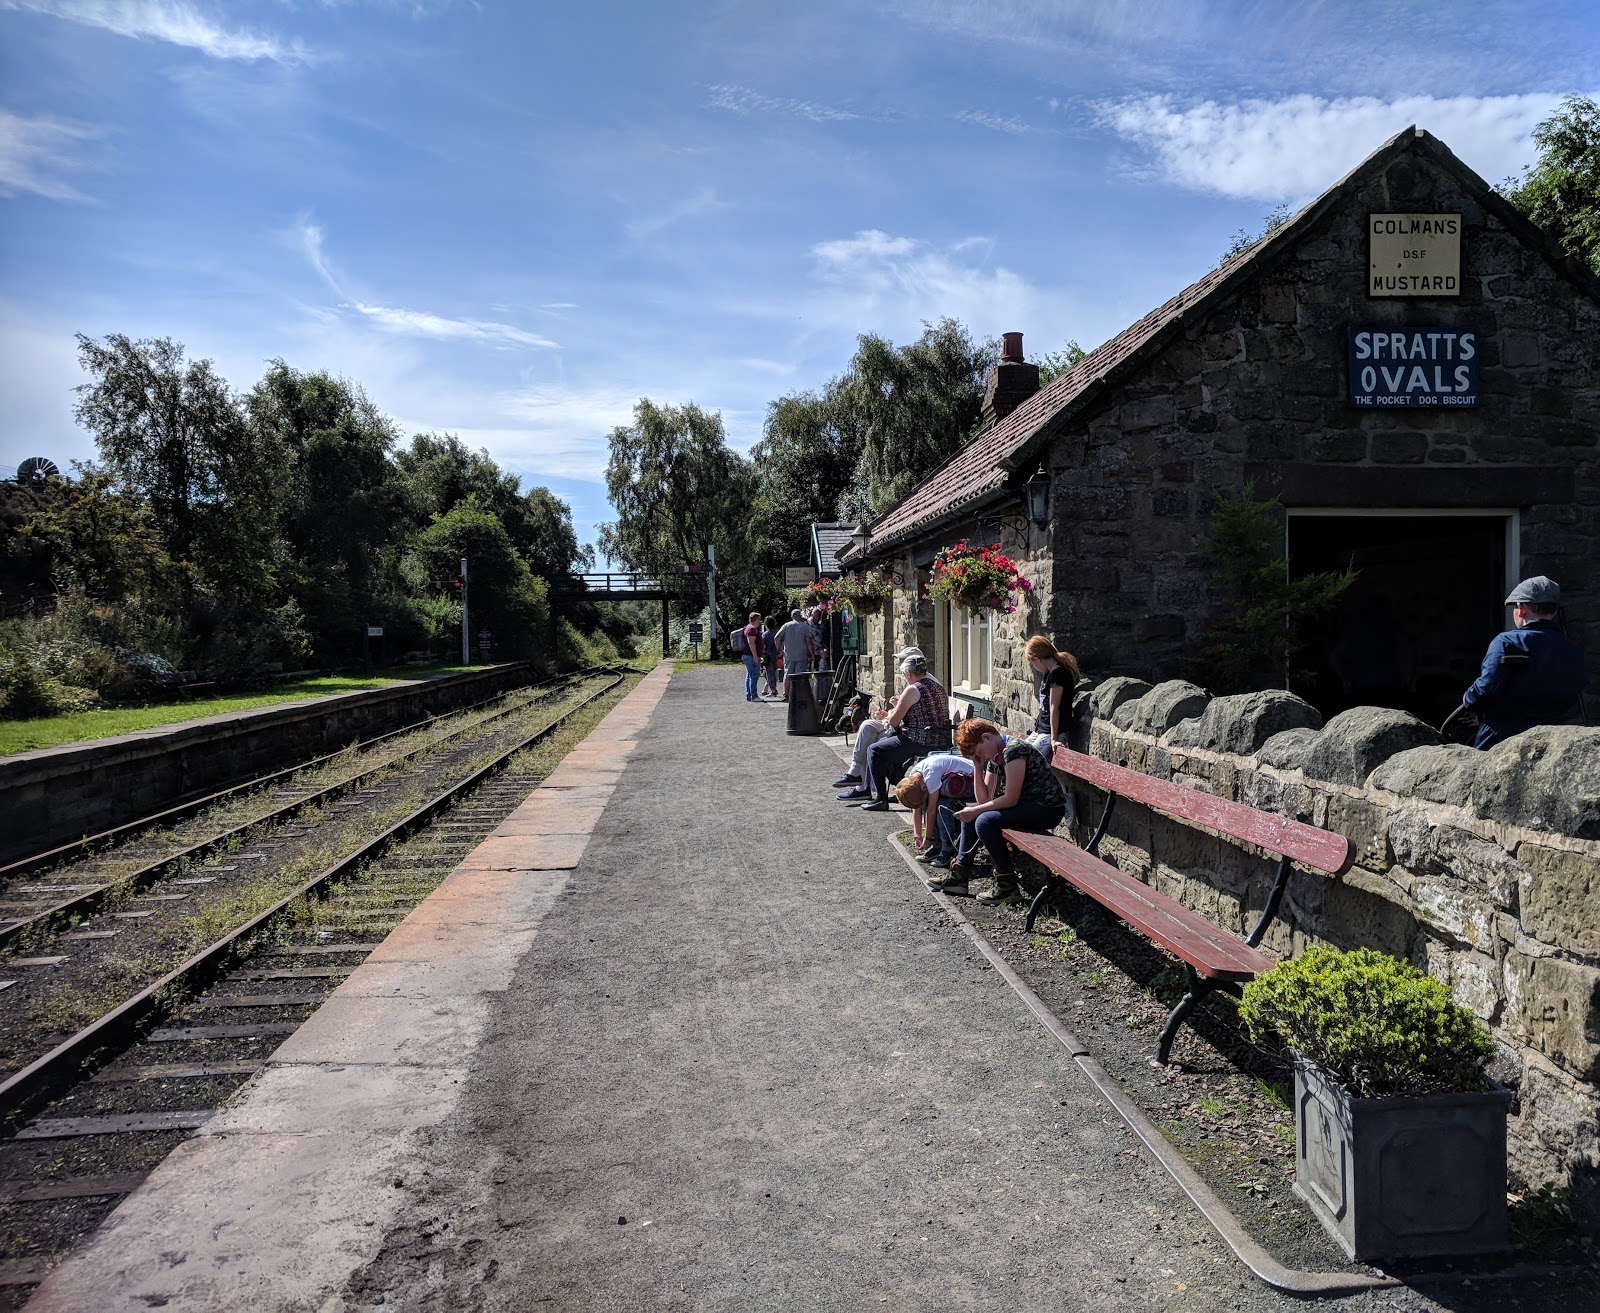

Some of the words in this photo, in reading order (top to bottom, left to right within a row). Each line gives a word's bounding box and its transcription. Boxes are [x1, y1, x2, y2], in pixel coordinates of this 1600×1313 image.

[1373, 218, 1458, 235] COLMAN'S
[1373, 275, 1456, 291] MUSTARD
[1354, 331, 1476, 360] SPRATTS
[1360, 365, 1470, 393] OVALS
[1354, 396, 1373, 405] THE
[1376, 396, 1412, 405] POCKET
[1419, 396, 1438, 405] DOG
[1442, 396, 1476, 405] BISCUIT
